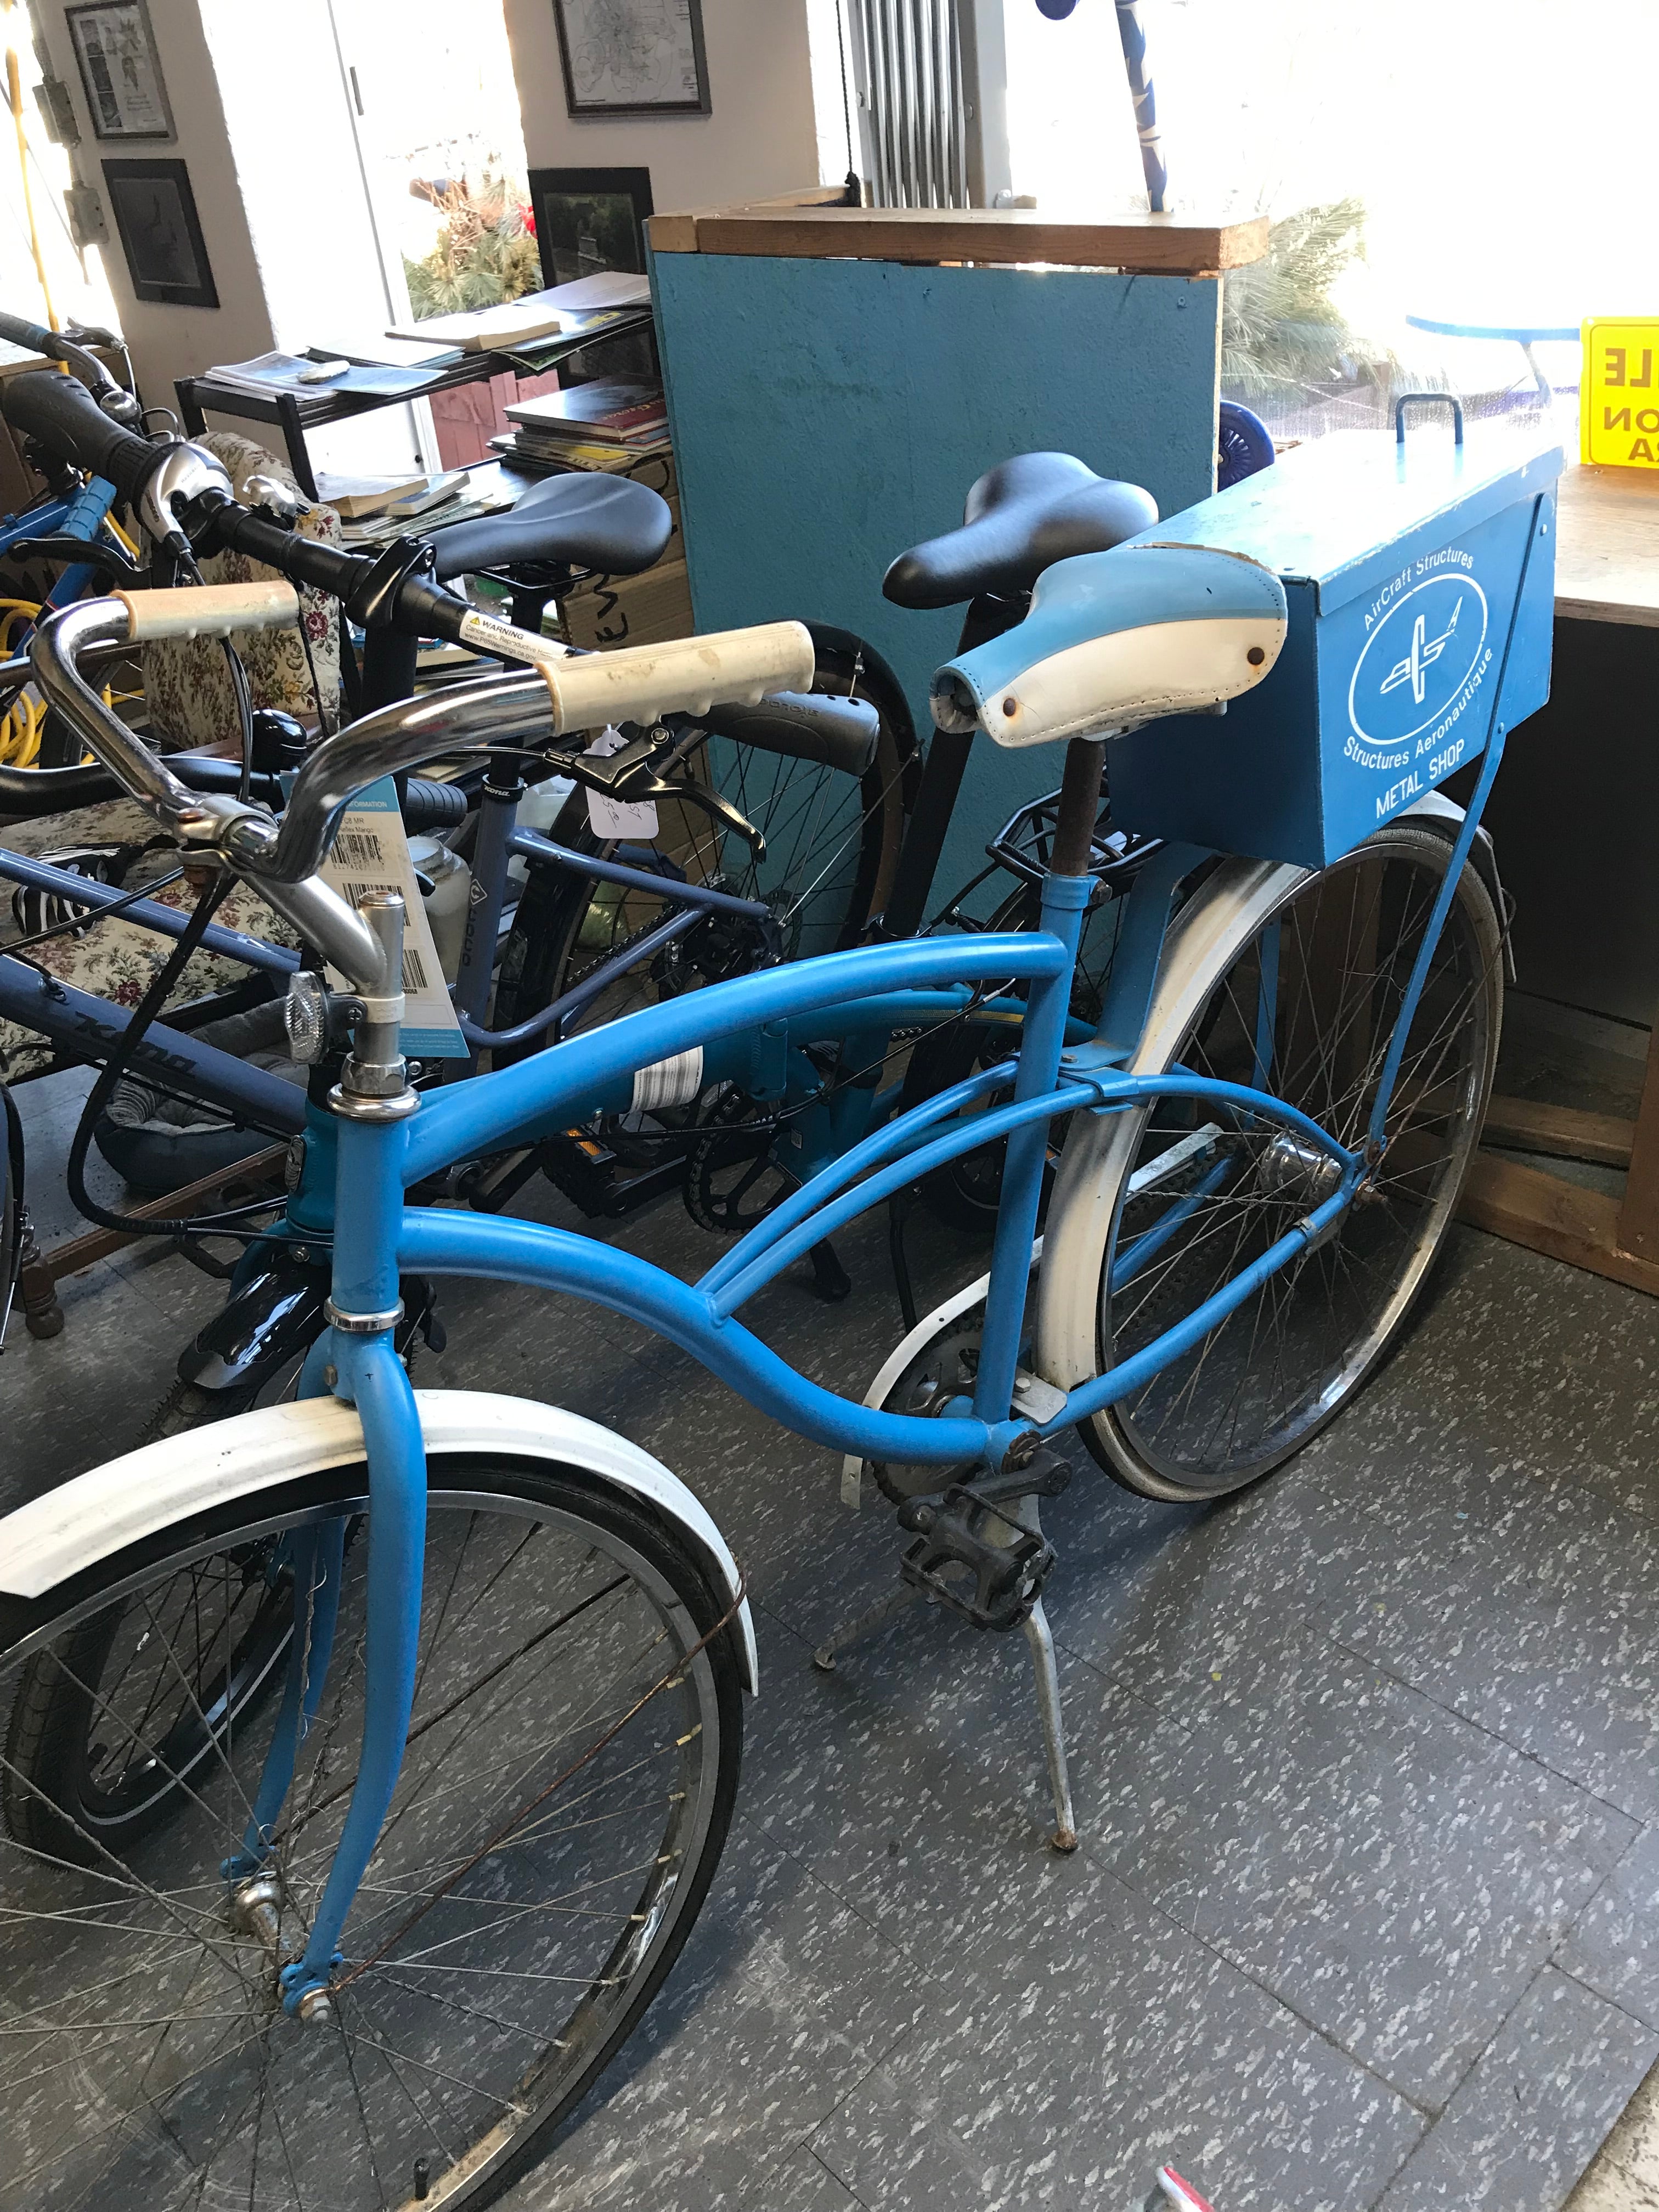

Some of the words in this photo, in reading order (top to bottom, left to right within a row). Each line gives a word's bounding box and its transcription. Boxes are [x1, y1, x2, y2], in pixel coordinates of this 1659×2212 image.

[1364, 567, 1412, 631] AirCraft
[1416, 546, 1475, 575] Structures
[466, 624, 487, 636] Cancer
[499, 635, 537, 653] Reproductive
[482, 620, 524, 640] WARNING
[1344, 736, 1409, 769] Structures
[1415, 648, 1493, 759] Aeronautique
[1376, 770, 1423, 819] METAL
[1429, 738, 1464, 781] SHOP
